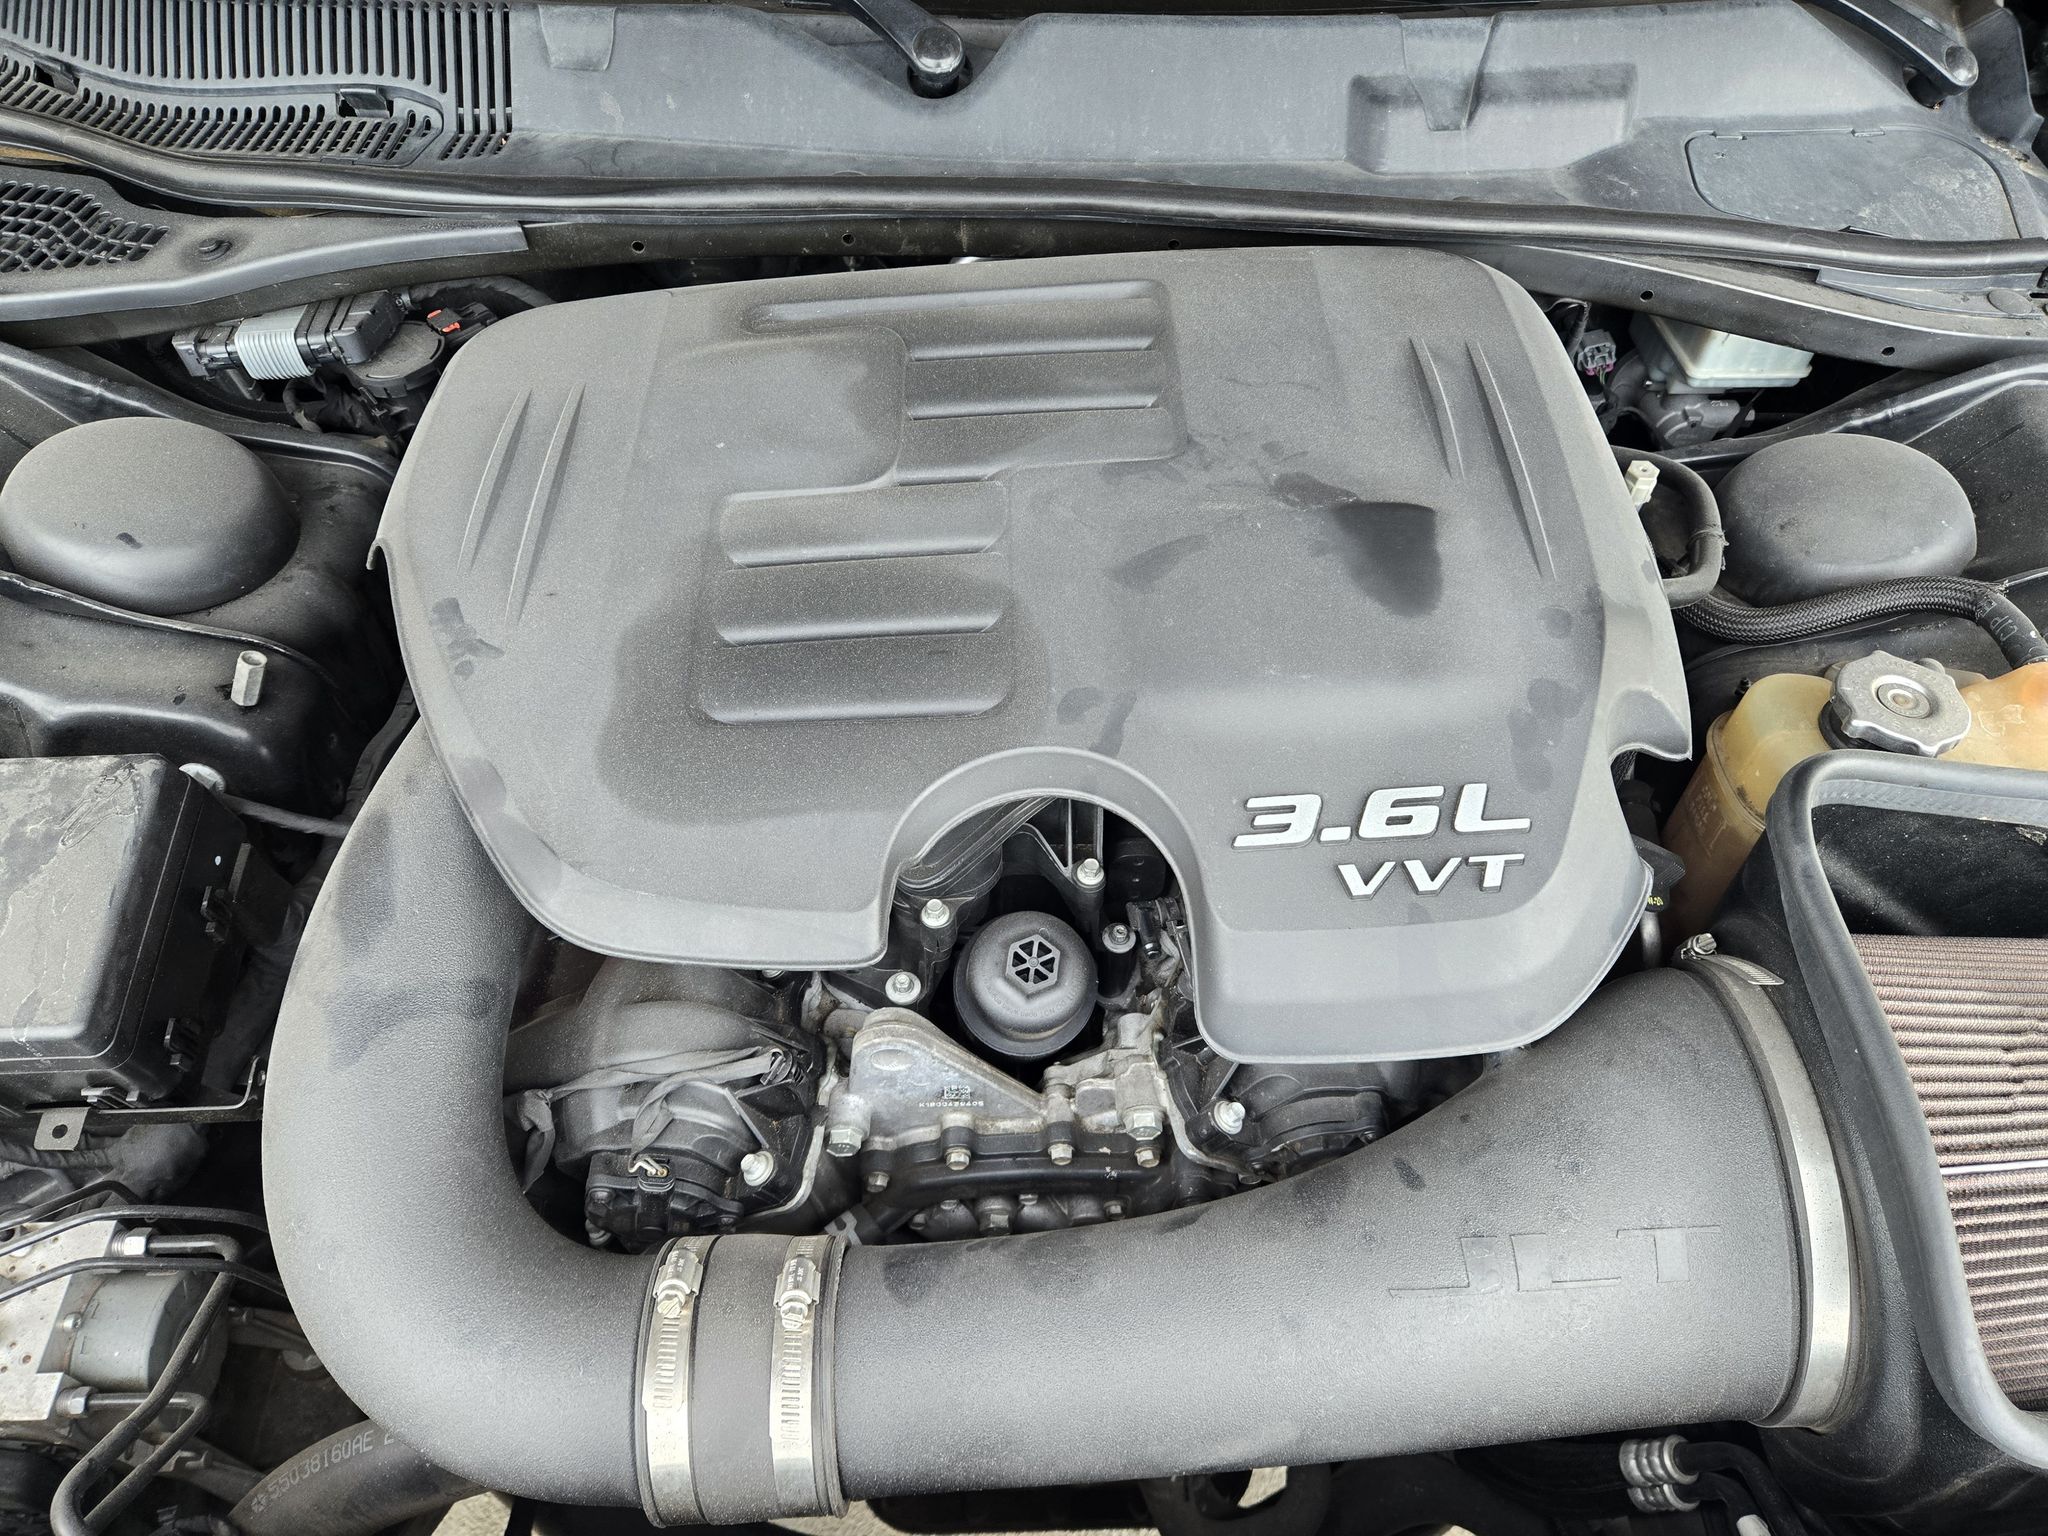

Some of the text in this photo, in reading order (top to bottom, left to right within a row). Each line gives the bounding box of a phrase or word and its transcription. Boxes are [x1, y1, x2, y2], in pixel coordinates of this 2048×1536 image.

[1232, 783, 1531, 849] 3.6L
[1336, 853, 1525, 900] VVT
[1388, 1225, 1721, 1298] JLT
[267, 1430, 374, 1499] 55038160AE
